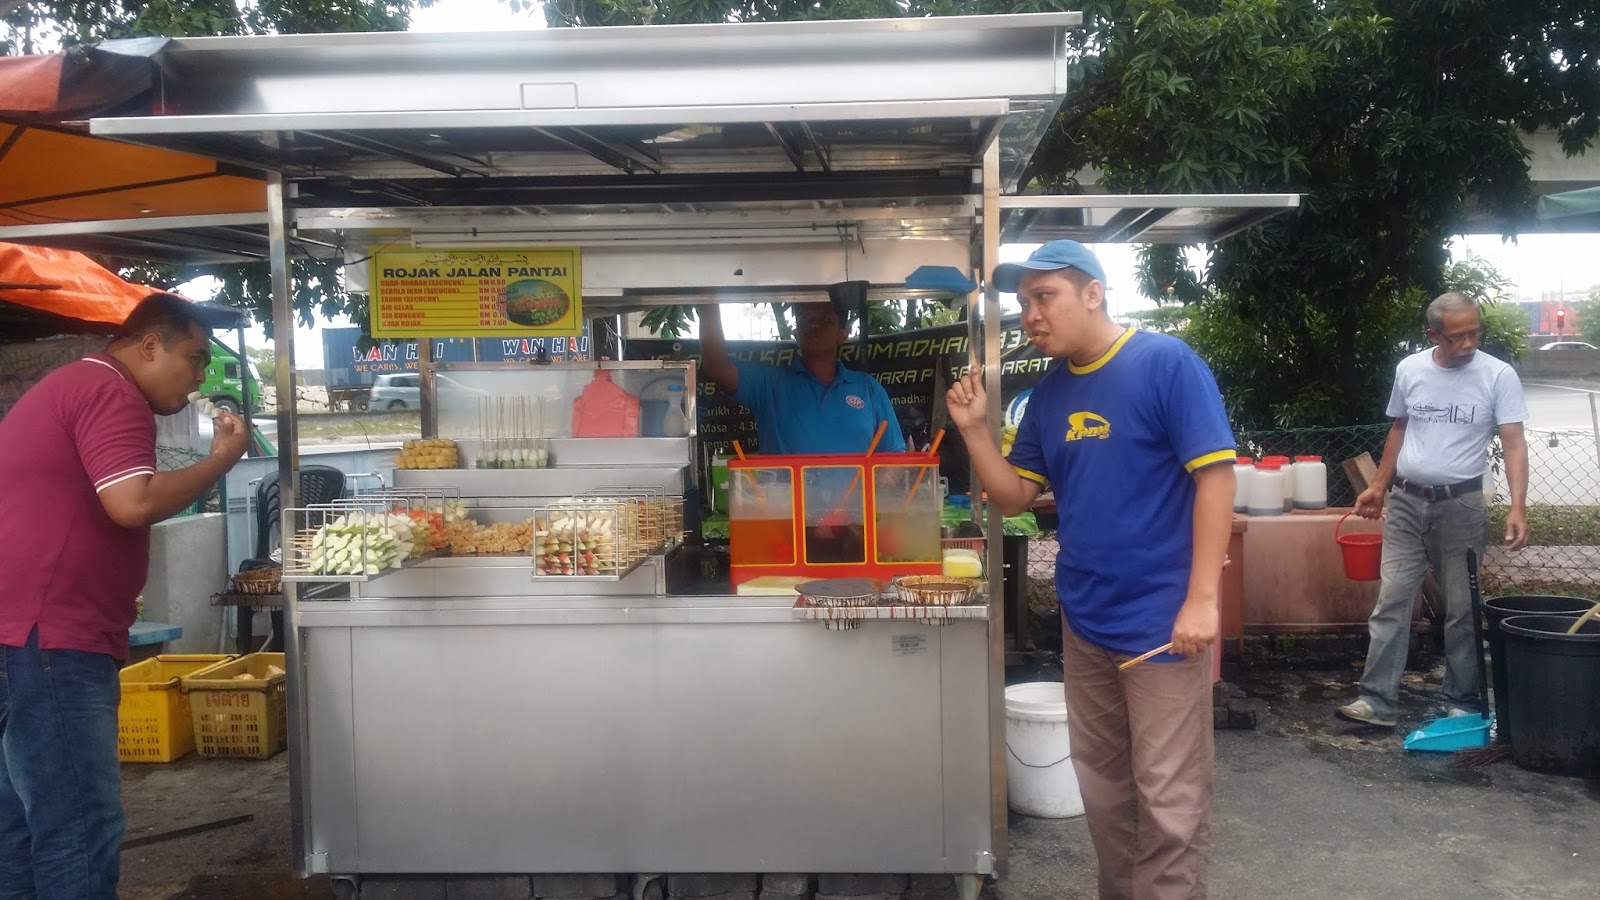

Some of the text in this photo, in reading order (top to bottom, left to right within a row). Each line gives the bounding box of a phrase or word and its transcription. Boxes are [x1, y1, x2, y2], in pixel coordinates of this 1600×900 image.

[383, 266, 567, 278] ROJAK JALAN PANTAI
[352, 342, 444, 362] WAN HI
[502, 336, 588, 356] WAN HAI
[405, 362, 418, 370] WE
[700, 424, 728, 433] Masa
